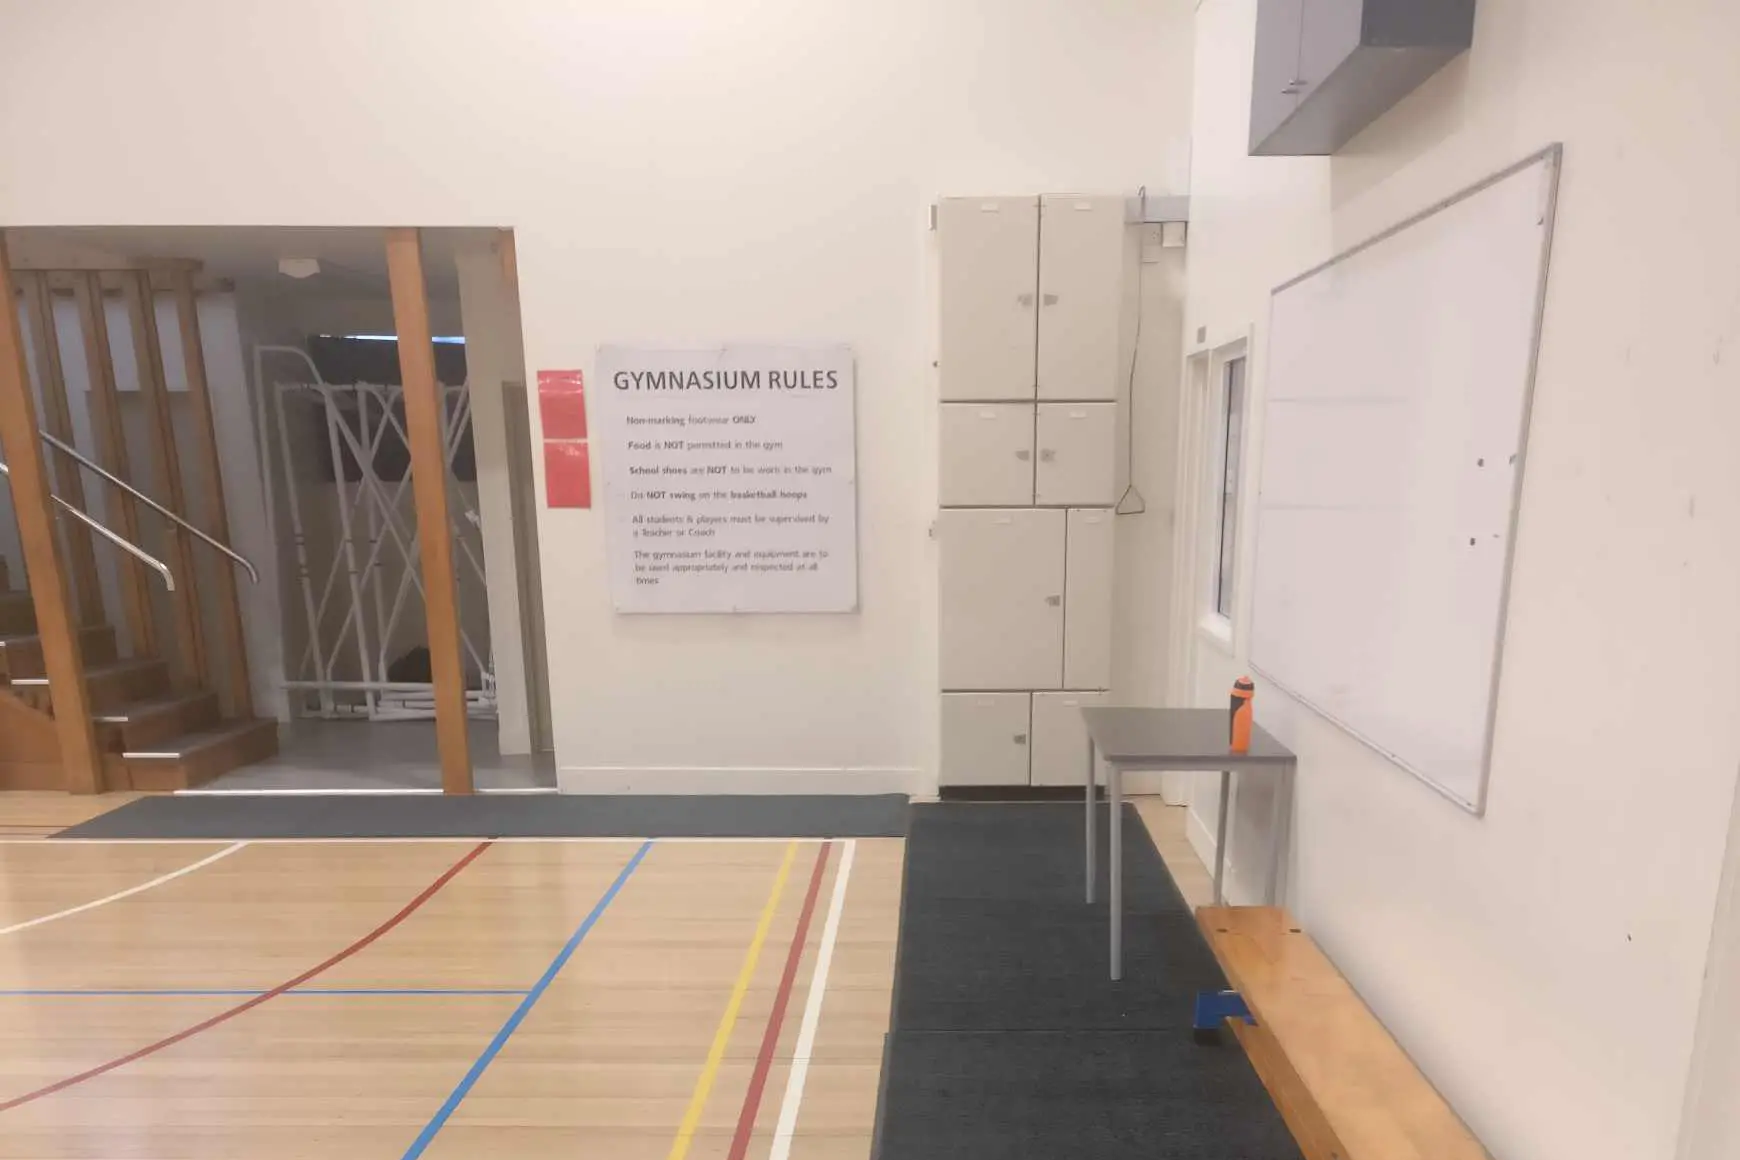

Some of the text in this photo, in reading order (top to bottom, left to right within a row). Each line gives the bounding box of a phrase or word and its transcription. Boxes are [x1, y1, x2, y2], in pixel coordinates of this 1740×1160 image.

[613, 370, 839, 391] GYMNASIUM RULES
[626, 415, 686, 427] Non-marking
[732, 414, 756, 424] ONLY
[628, 440, 652, 450] Food
[664, 440, 684, 450] NOT
[687, 440, 731, 452] permitted
[734, 440, 743, 450] in
[745, 440, 761, 450] the
[762, 441, 783, 452] gym
[629, 465, 659, 475] School
[661, 465, 688, 475] shoes
[706, 465, 727, 475] NOT
[730, 465, 740, 475] to
[794, 465, 809, 475] the
[811, 466, 833, 476] gym
[630, 489, 808, 502] Do NOT swing on the basketball hoops
[632, 512, 831, 526] All students & players must be supervised by
[642, 527, 672, 538] Teacher
[688, 527, 716, 537] Coach
[633, 549, 650, 560] The
[652, 551, 702, 562] gymnasium
[704, 548, 732, 560] facility
[734, 549, 751, 558] and
[672, 563, 729, 575] appropriately
[731, 562, 748, 572] and
[750, 562, 794, 573] respected
[636, 576, 661, 586] times
